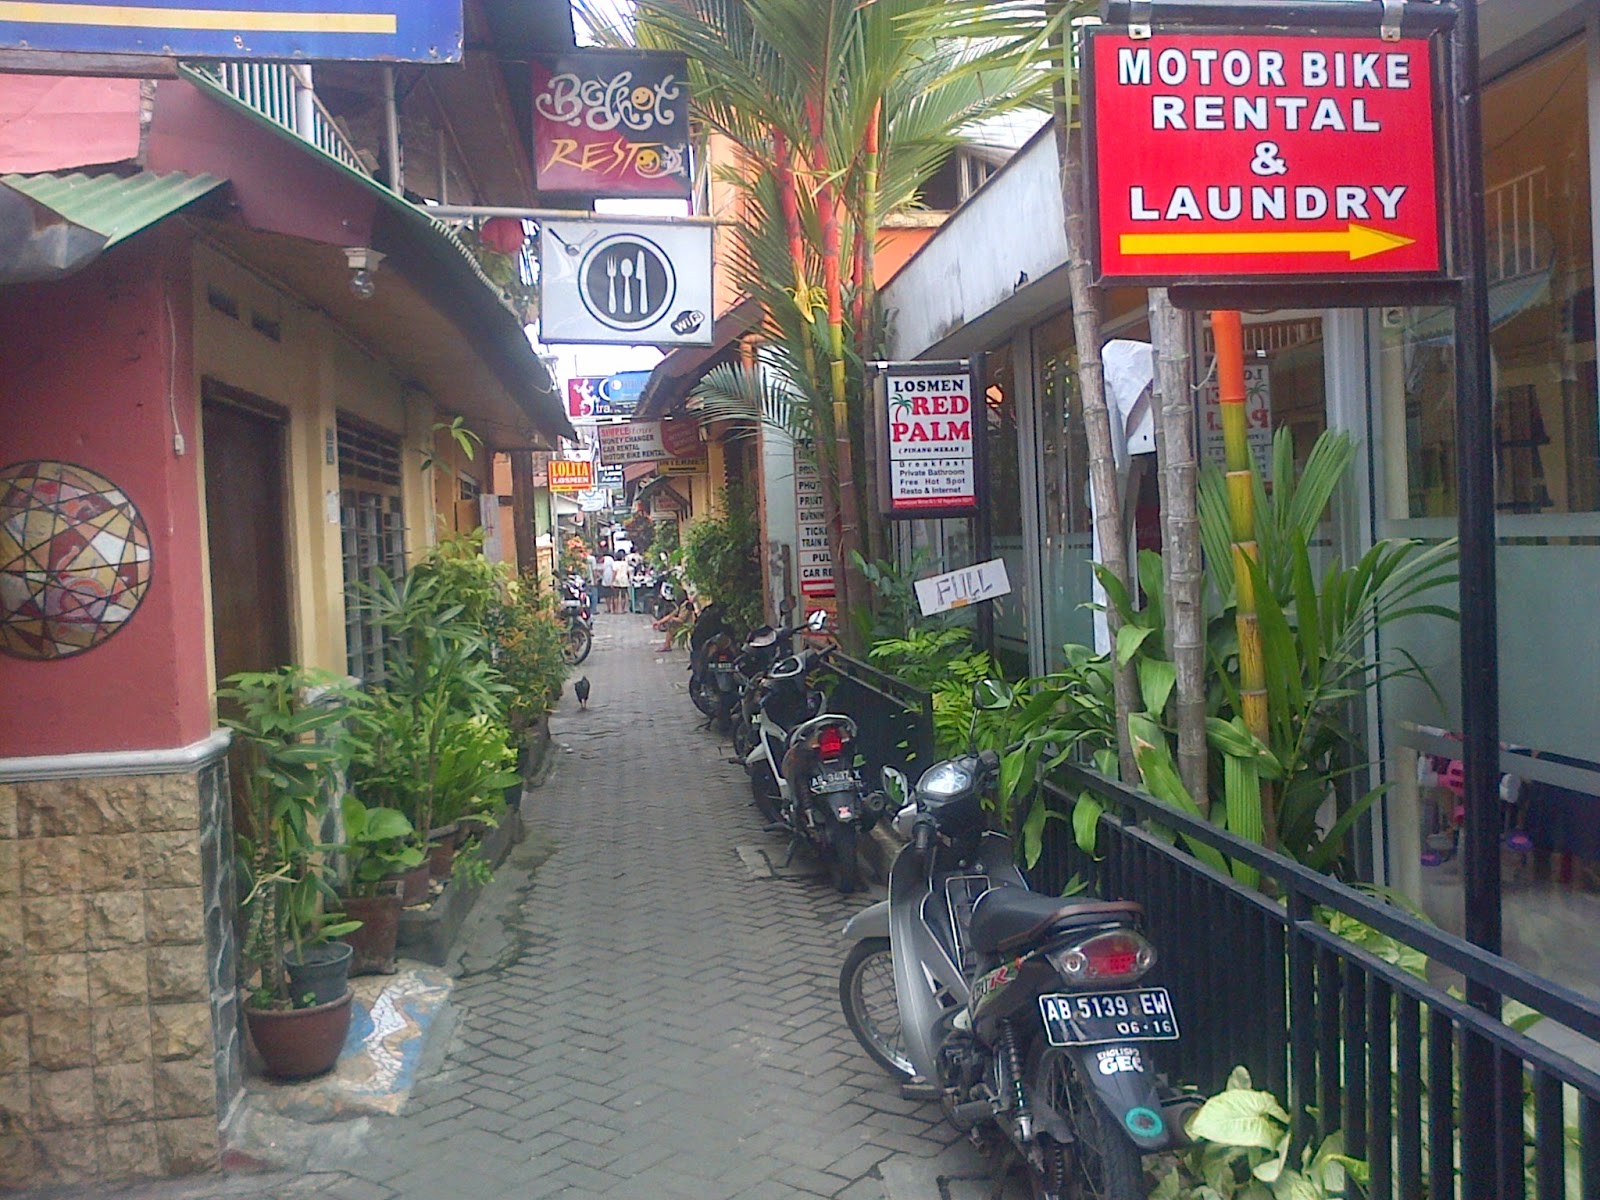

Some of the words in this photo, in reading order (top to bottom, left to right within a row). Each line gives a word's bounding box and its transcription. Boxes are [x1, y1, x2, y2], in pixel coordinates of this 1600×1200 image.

[1118, 47, 1286, 87] MOTOR
[1302, 50, 1411, 89] BIKE
[1152, 94, 1381, 132] RENTAL
[1250, 140, 1288, 176] &
[1129, 185, 1407, 221] LAUNDRY
[894, 379, 964, 393] LOSMEN
[912, 394, 970, 416] RED
[601, 427, 630, 437] SIMPLE
[891, 421, 970, 442] PALM
[601, 437, 624, 445] MONEY
[625, 434, 654, 443] CHANGER
[616, 444, 640, 452] RENTAL
[603, 453, 625, 461] MOTOR
[626, 451, 640, 459] BIKE
[552, 462, 589, 476] LOLITA
[899, 460, 965, 468] Breakfast
[899, 469, 926, 477] Private
[928, 468, 965, 476] Bathroom
[900, 478, 918, 486] Free
[946, 477, 965, 486] Spot
[900, 487, 922, 495] Resto
[932, 486, 961, 494] Internet
[805, 527, 828, 536] TICK
[802, 538, 822, 547] TRAIN
[812, 553, 832, 562] PUL
[803, 568, 820, 578] CAR
[822, 568, 833, 577] RE
[936, 568, 994, 606] FULL
[1047, 1001, 1072, 1022] AB
[1079, 996, 1129, 1020] 5139
[1140, 993, 1168, 1015] EW
